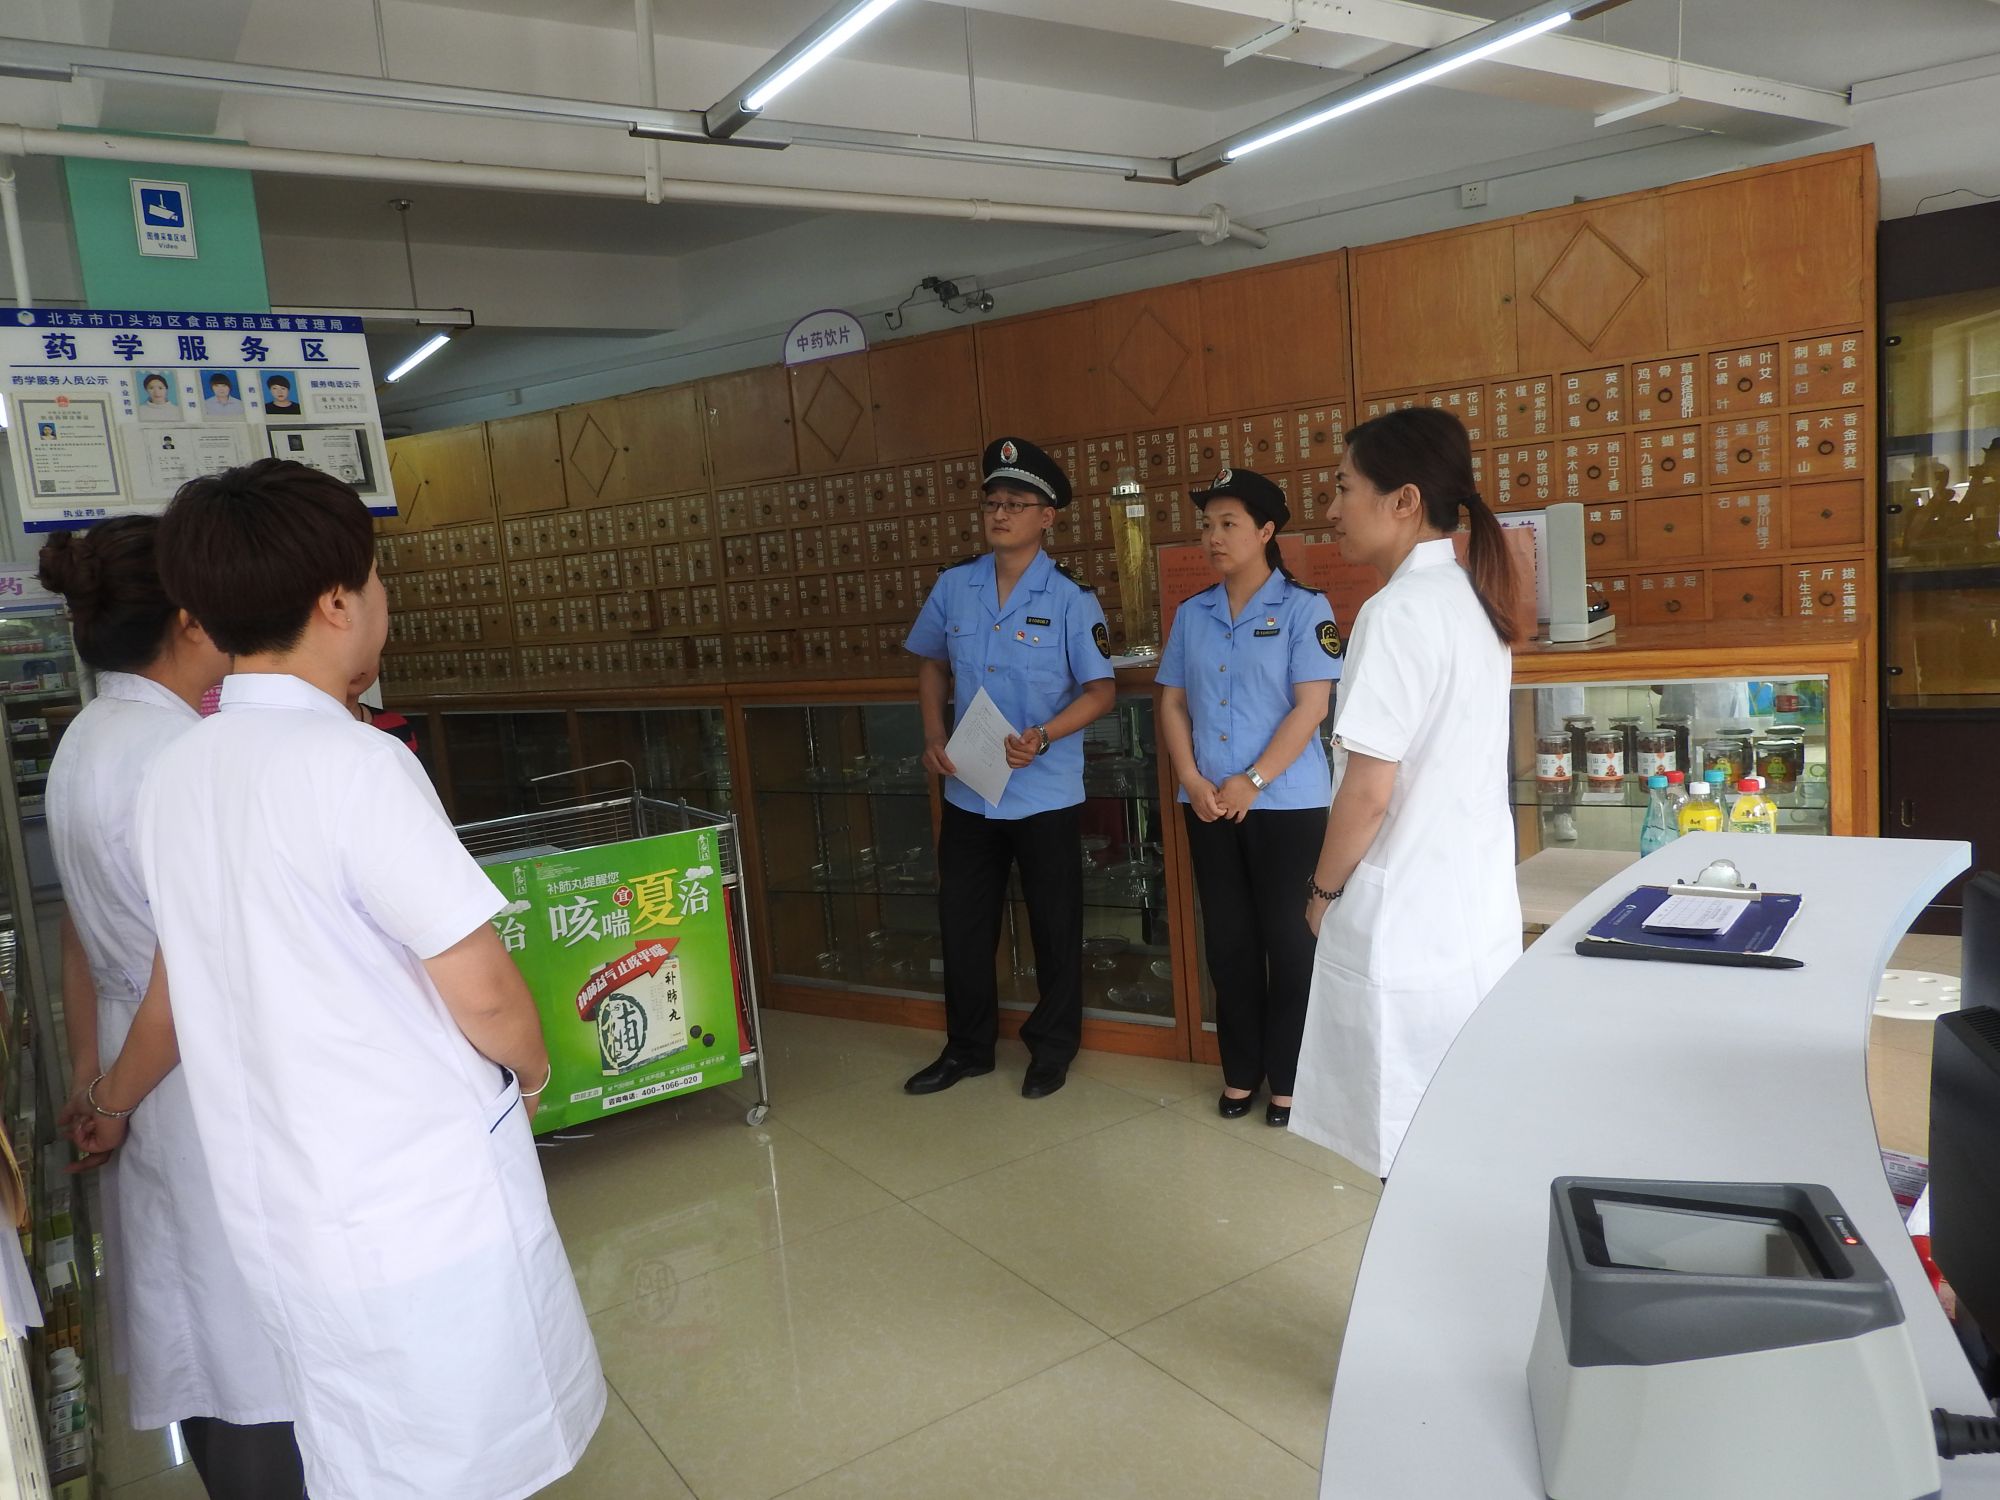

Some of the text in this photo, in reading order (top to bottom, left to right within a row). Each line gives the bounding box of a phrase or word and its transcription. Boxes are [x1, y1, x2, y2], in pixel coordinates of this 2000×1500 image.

[48, 312, 343, 331] 北京市门头沟区食品药品监督管理局
[44, 333, 328, 362] 药学服务区
[797, 325, 850, 352] 中药饮片
[11, 376, 109, 386] 药学服务人员公示
[311, 380, 361, 389] 服务电话公示
[63, 508, 106, 517] 执业药师
[547, 871, 620, 895] 补肺丸提醒您
[617, 943, 669, 977] 止咳平喘
[664, 971, 681, 1022] 补肺丸
[641, 1075, 698, 1097] 400-1066-020
